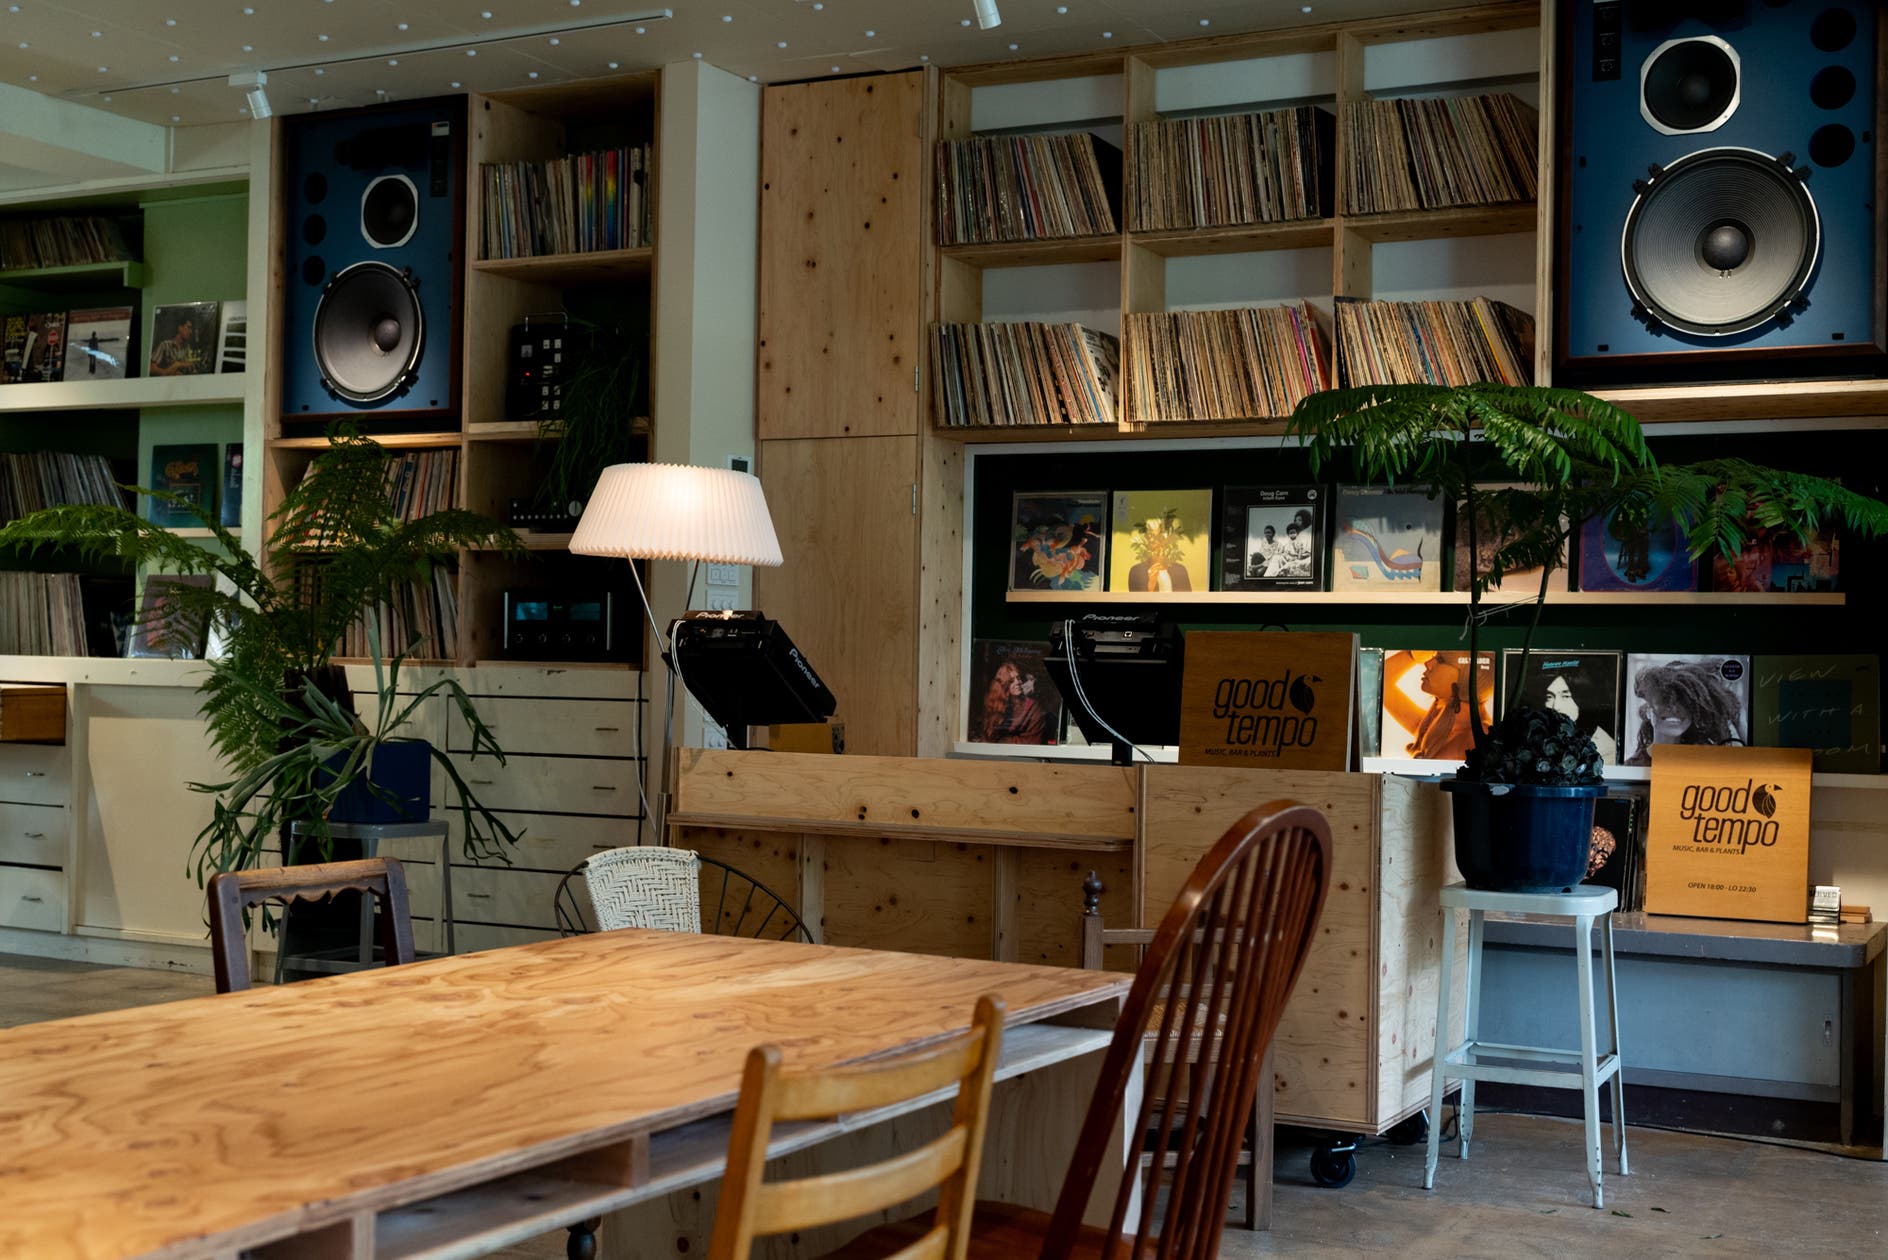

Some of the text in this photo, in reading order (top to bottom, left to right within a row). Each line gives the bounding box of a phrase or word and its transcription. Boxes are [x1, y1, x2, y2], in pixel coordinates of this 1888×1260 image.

[695, 611, 745, 619] Pioner
[1082, 613, 1141, 621] Pioneer
[788, 647, 821, 689] Pioneer
[1759, 663, 1838, 689] VIEW
[1213, 669, 1291, 719] good
[1768, 703, 1866, 726] WITH A
[1226, 709, 1318, 758] tempo
[1228, 748, 1244, 757] BAR
[1250, 749, 1276, 758] PLANTS
[1680, 778, 1753, 820] good
[1692, 812, 1780, 855] tempo
[1672, 844, 1695, 853] MUSIC,
[1696, 845, 1709, 853] BAR
[1715, 847, 1741, 855] PLANTS
[1687, 881, 1706, 889] OPEN
[1707, 883, 1725, 891] 18:00
[1728, 884, 1738, 892] LO
[1738, 885, 1757, 893] 22:30
